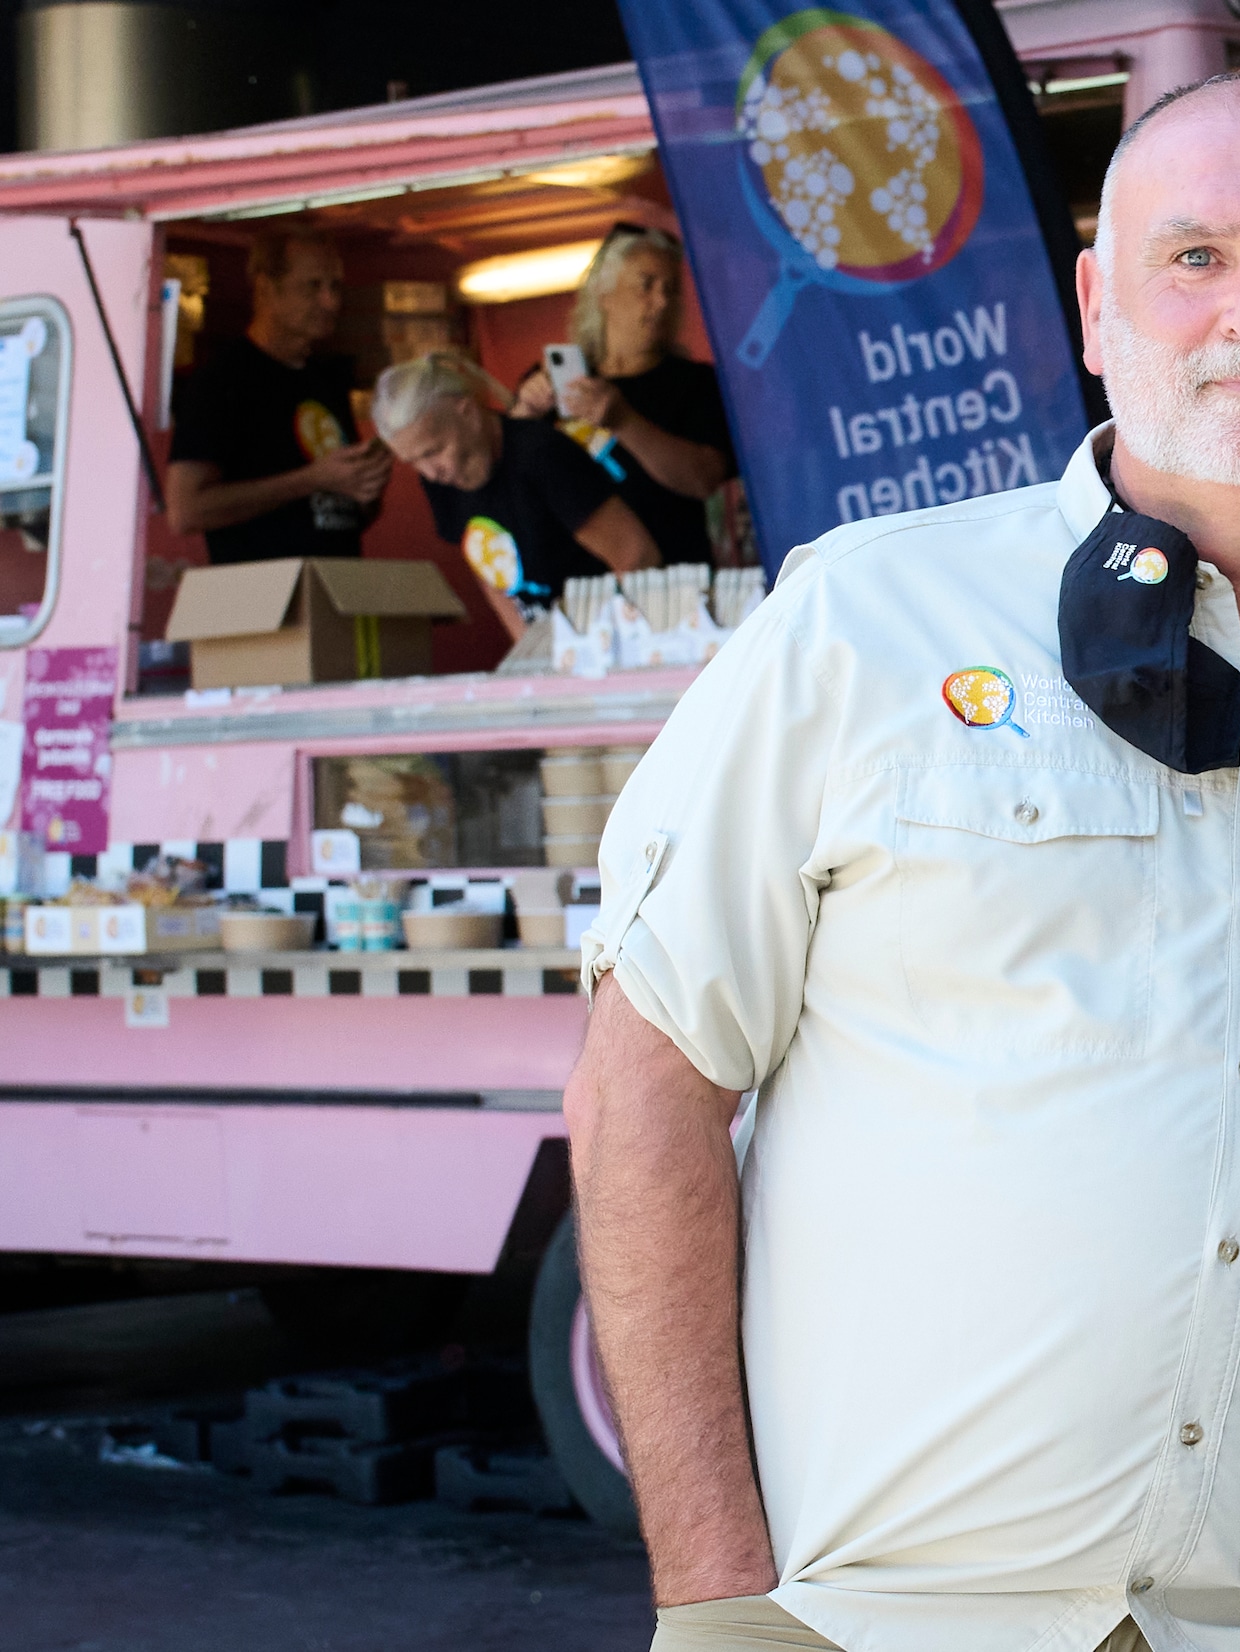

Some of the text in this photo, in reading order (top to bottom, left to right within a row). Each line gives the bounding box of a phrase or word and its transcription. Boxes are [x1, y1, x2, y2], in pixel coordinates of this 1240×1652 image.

[1103, 542, 1123, 569] Kitchen
[1110, 543, 1130, 570] Central
[1120, 544, 1137, 566] World
[1024, 707, 1096, 730] Kitchen
